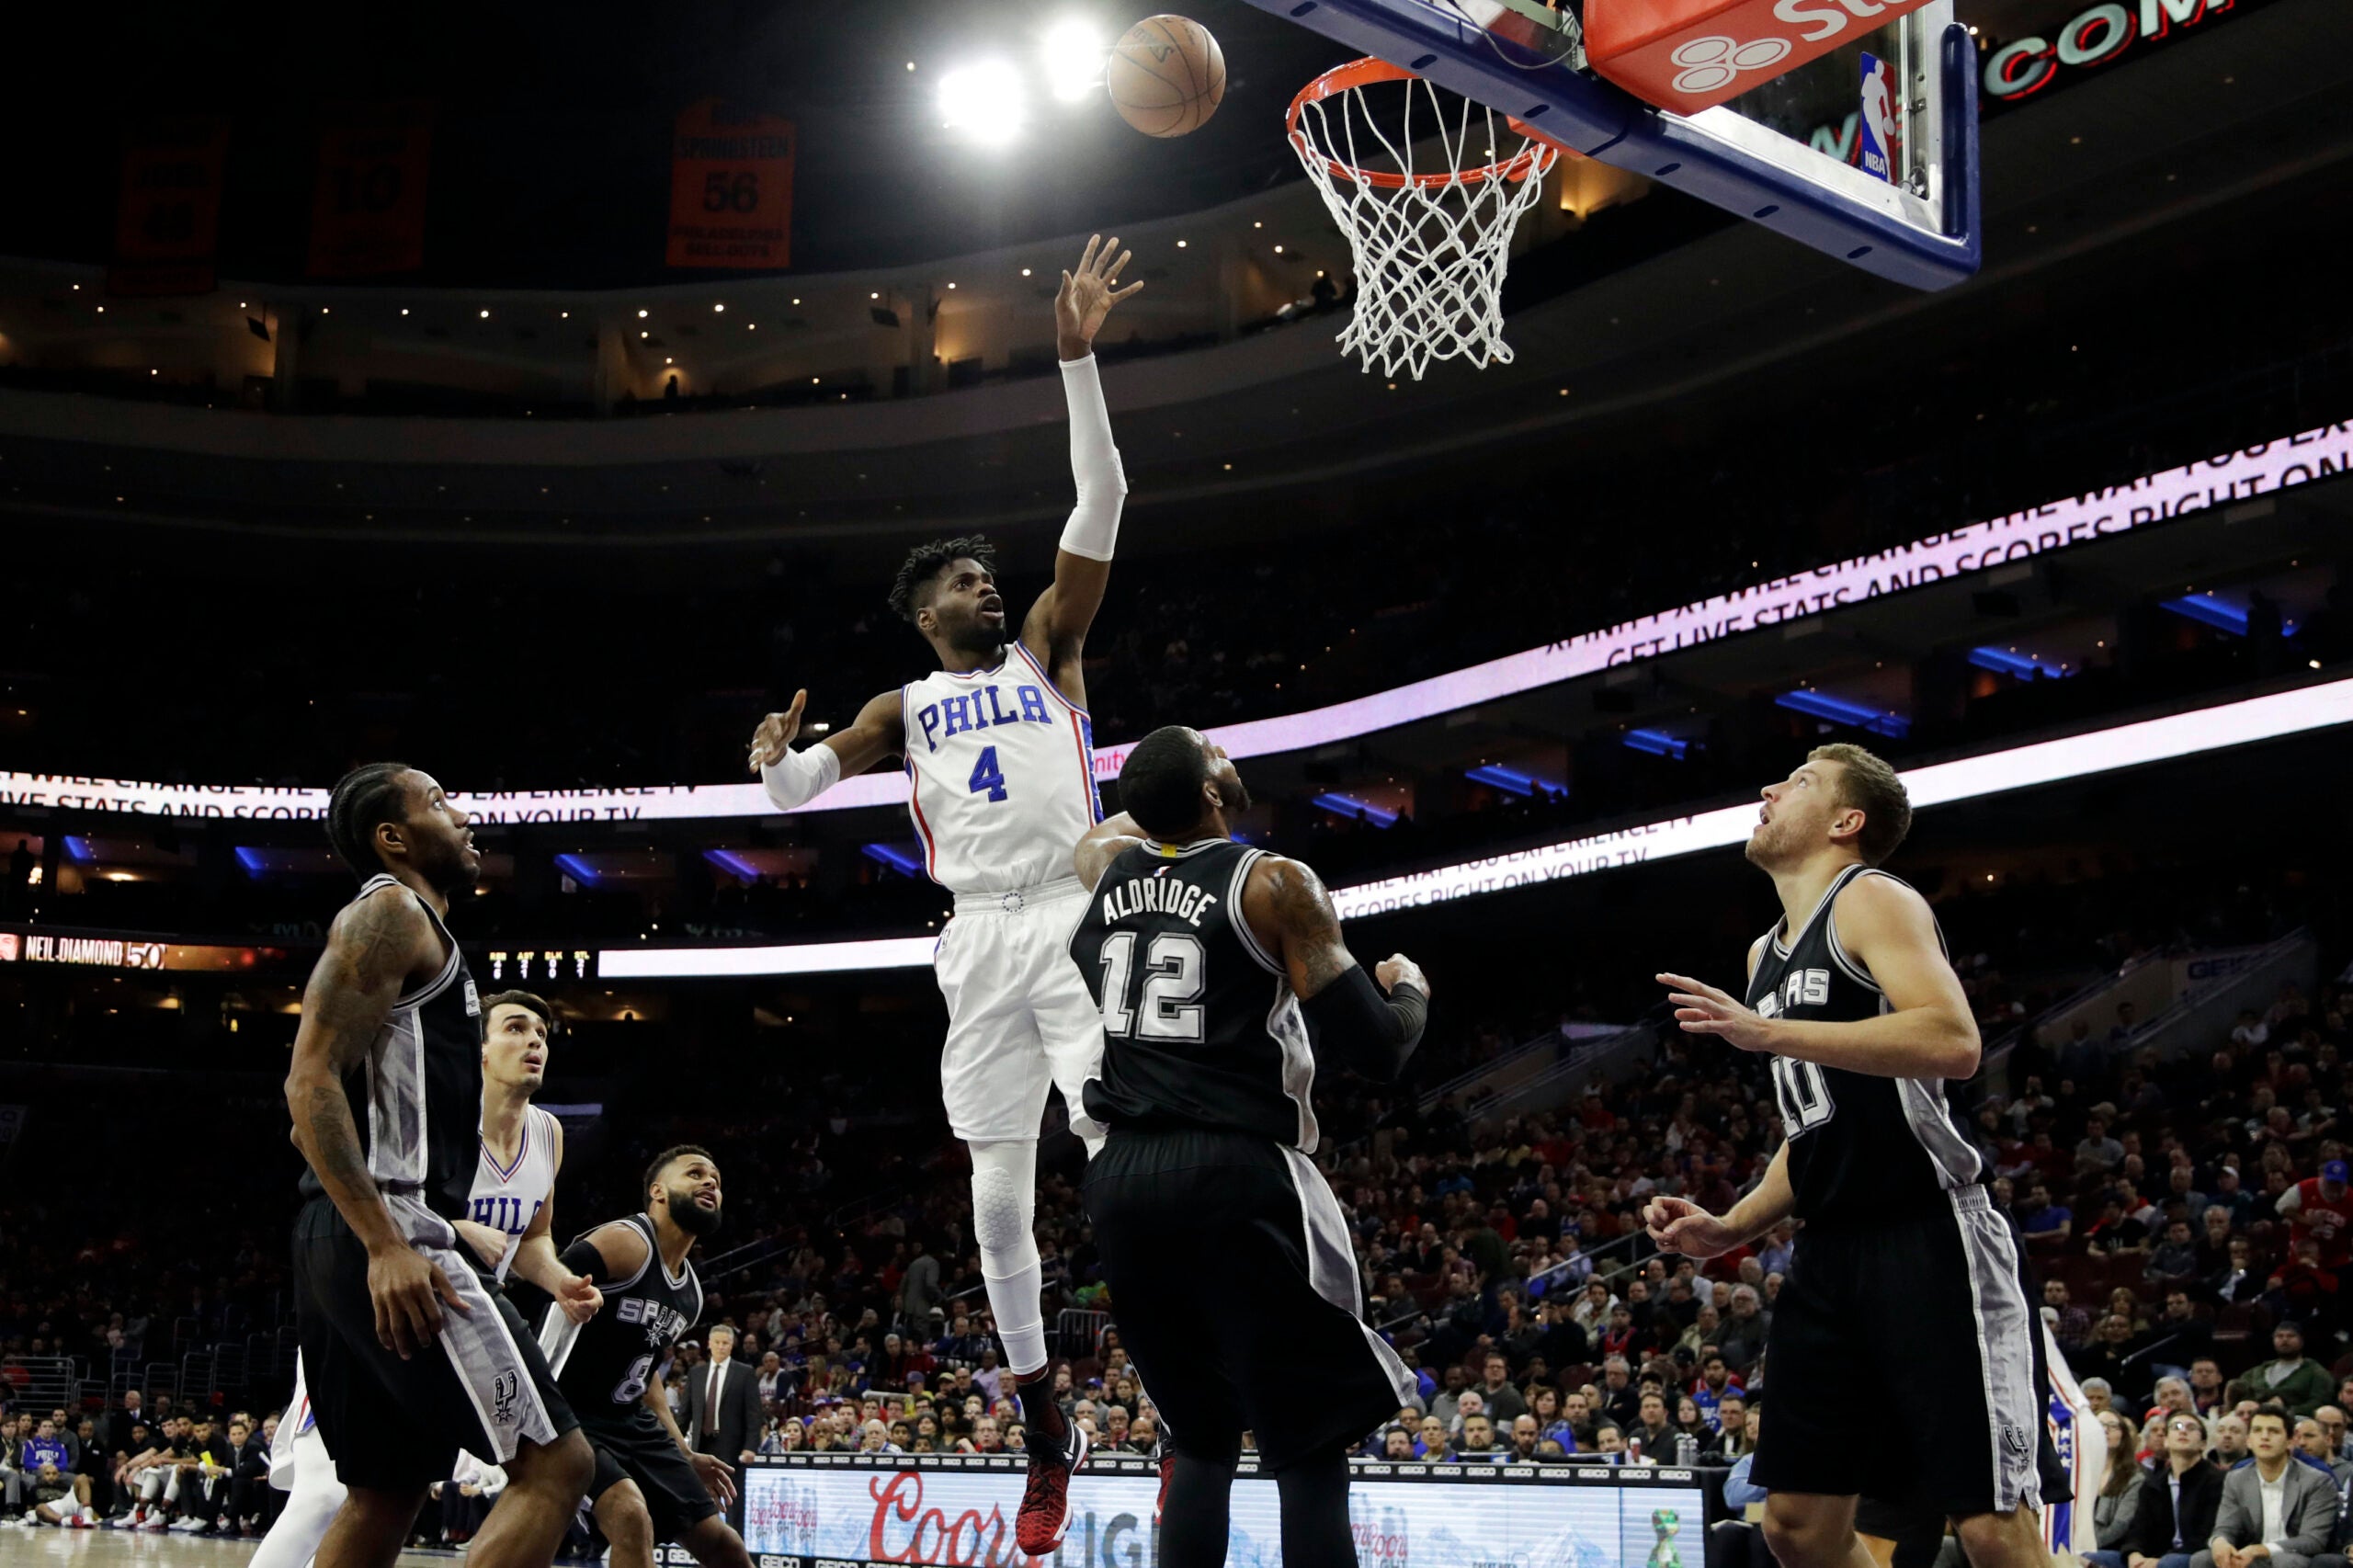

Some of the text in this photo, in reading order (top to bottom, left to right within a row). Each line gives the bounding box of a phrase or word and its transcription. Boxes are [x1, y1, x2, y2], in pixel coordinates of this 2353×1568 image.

[1864, 150, 1886, 176] NBA
[704, 172, 759, 213] 56
[918, 685, 1053, 754] PHILA
[968, 744, 1008, 803] 4
[1102, 876, 1219, 927] ALDRIDGE
[517, 951, 535, 960] AST
[544, 951, 563, 960] BLK
[574, 951, 590, 960] STL
[1097, 930, 1207, 1045] 12
[1769, 1055, 1836, 1142] 10
[466, 1197, 543, 1236] HIL
[610, 1353, 654, 1405] 8
[667, 1548, 700, 1564] GEI
[760, 1554, 801, 1568] GEICO
